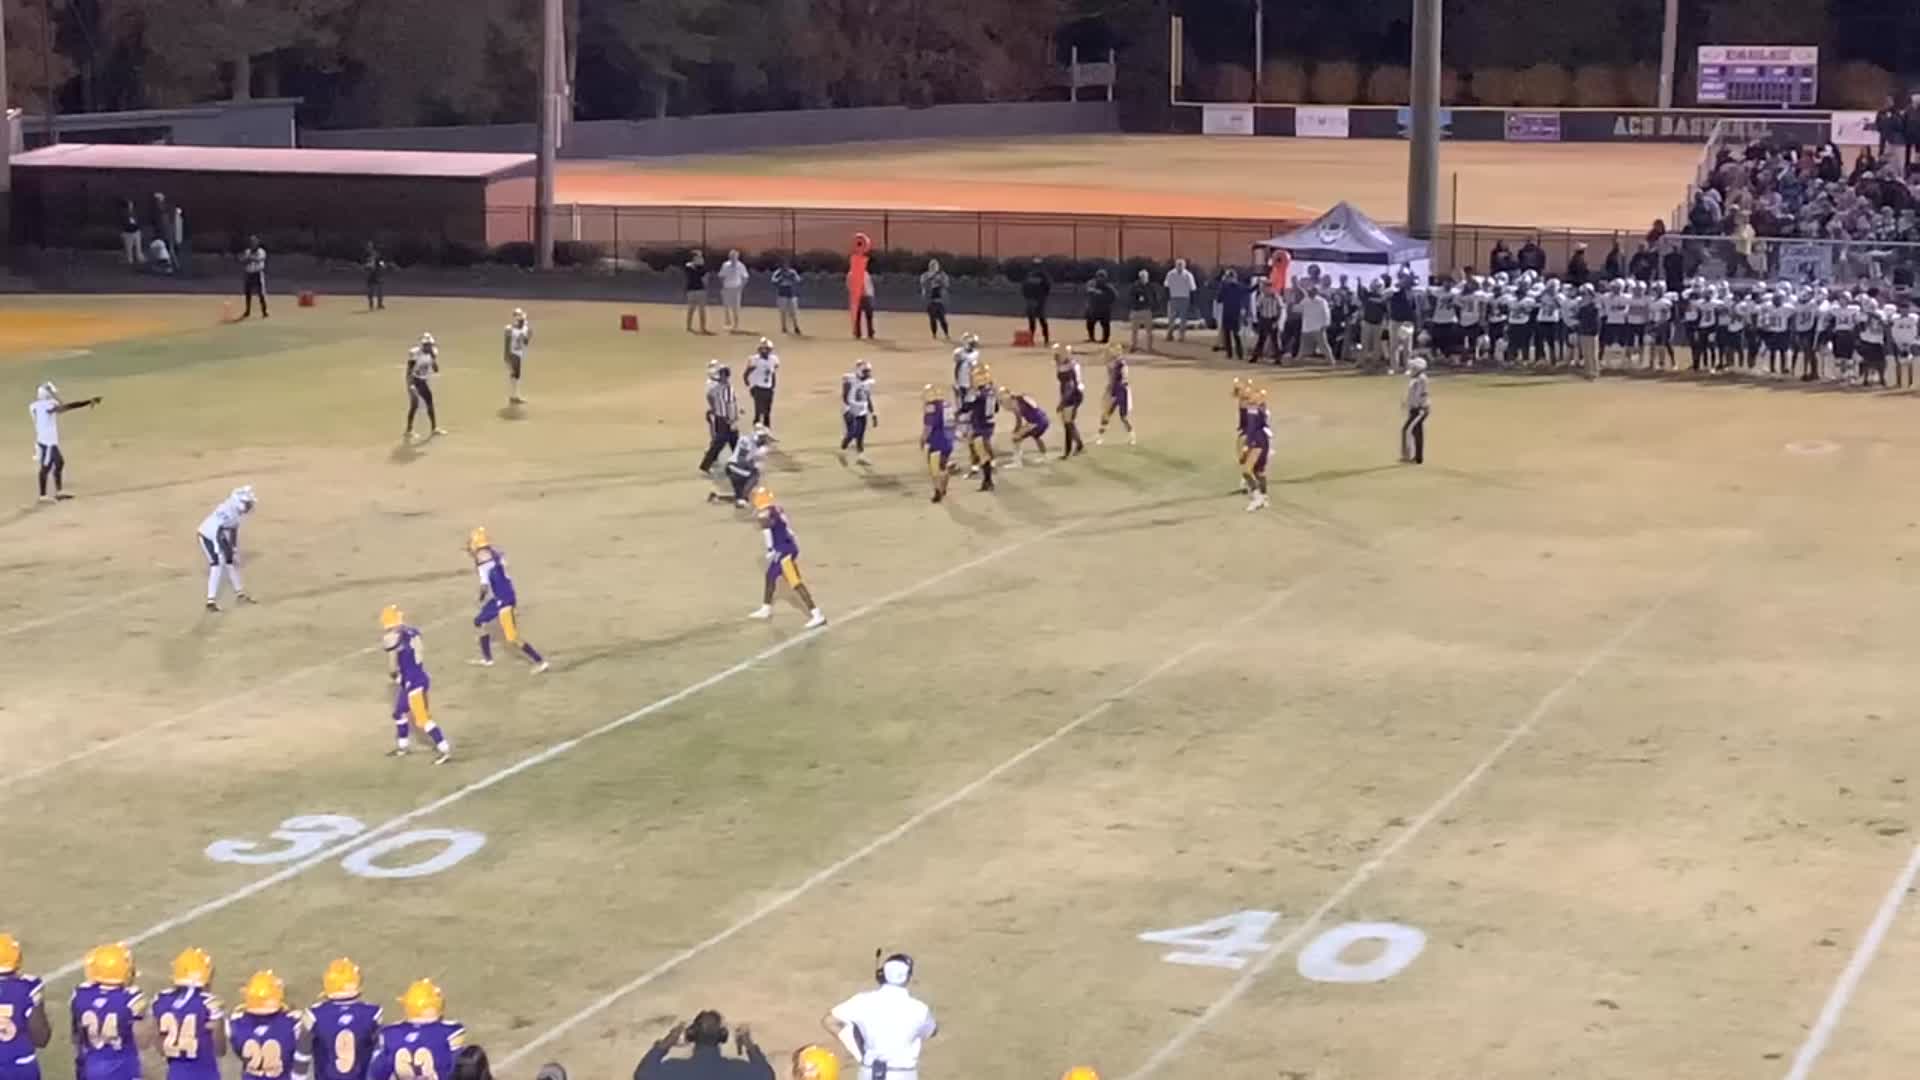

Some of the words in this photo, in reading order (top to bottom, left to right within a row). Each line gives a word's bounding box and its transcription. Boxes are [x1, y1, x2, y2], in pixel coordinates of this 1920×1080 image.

[204, 813, 487, 879] 30
[1136, 909, 1428, 984] 40
[159, 1012, 199, 1059] 24
